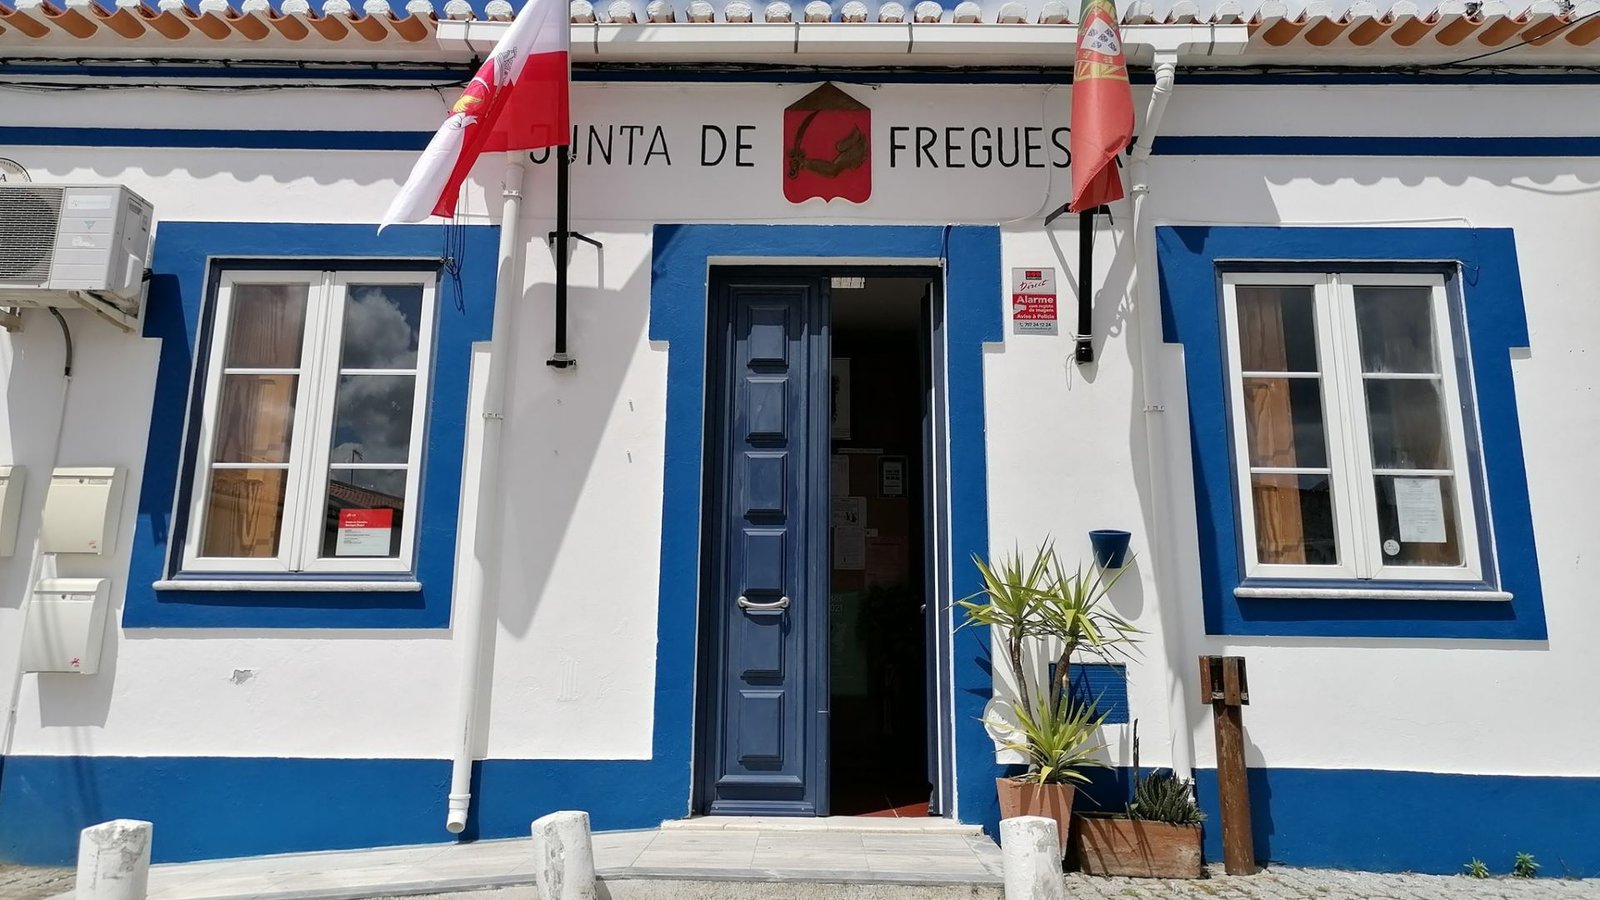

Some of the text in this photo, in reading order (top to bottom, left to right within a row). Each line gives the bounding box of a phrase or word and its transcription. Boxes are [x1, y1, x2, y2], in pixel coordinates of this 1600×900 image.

[700, 125, 757, 168] DE
[889, 125, 1123, 169] FREGUES
[1017, 295, 1054, 303] Alarme
